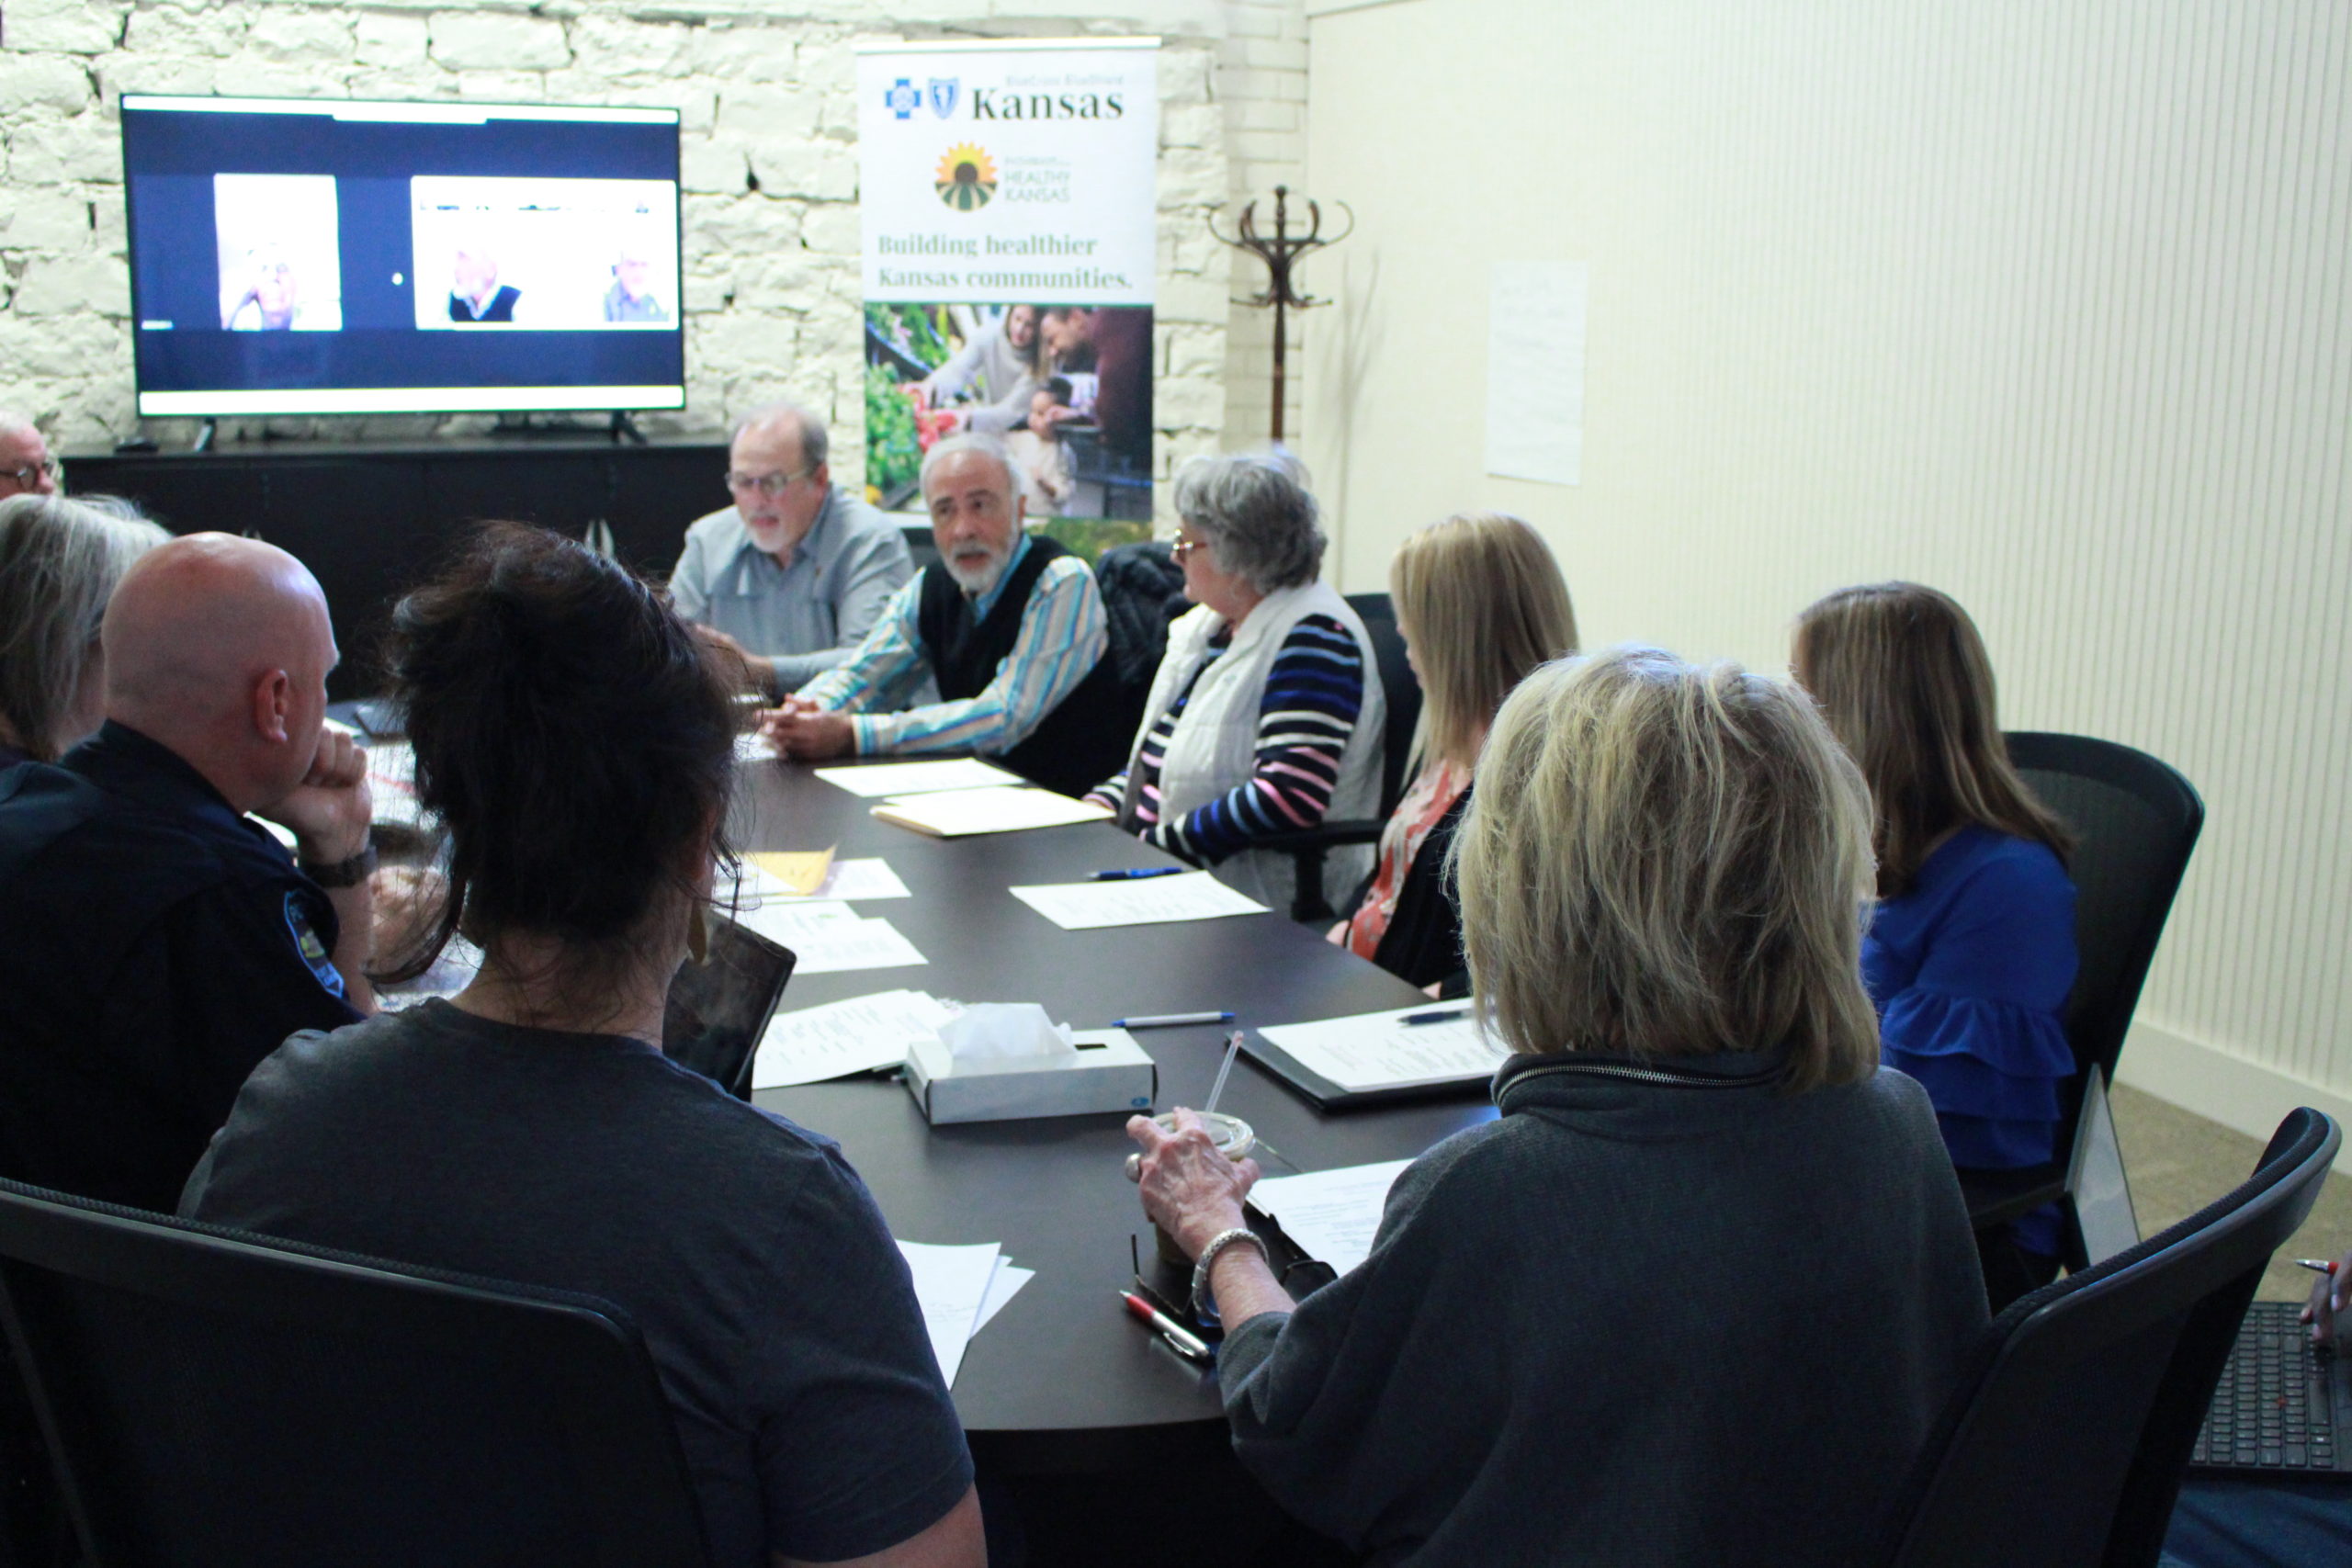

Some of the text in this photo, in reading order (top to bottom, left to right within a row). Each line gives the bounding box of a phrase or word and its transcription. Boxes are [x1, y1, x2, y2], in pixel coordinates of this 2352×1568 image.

[974, 89, 1124, 120] Kansas
[1004, 187, 1070, 202] KANSAS
[878, 234, 1098, 257] Building healthier
[878, 267, 1133, 289] Kansas communities.
